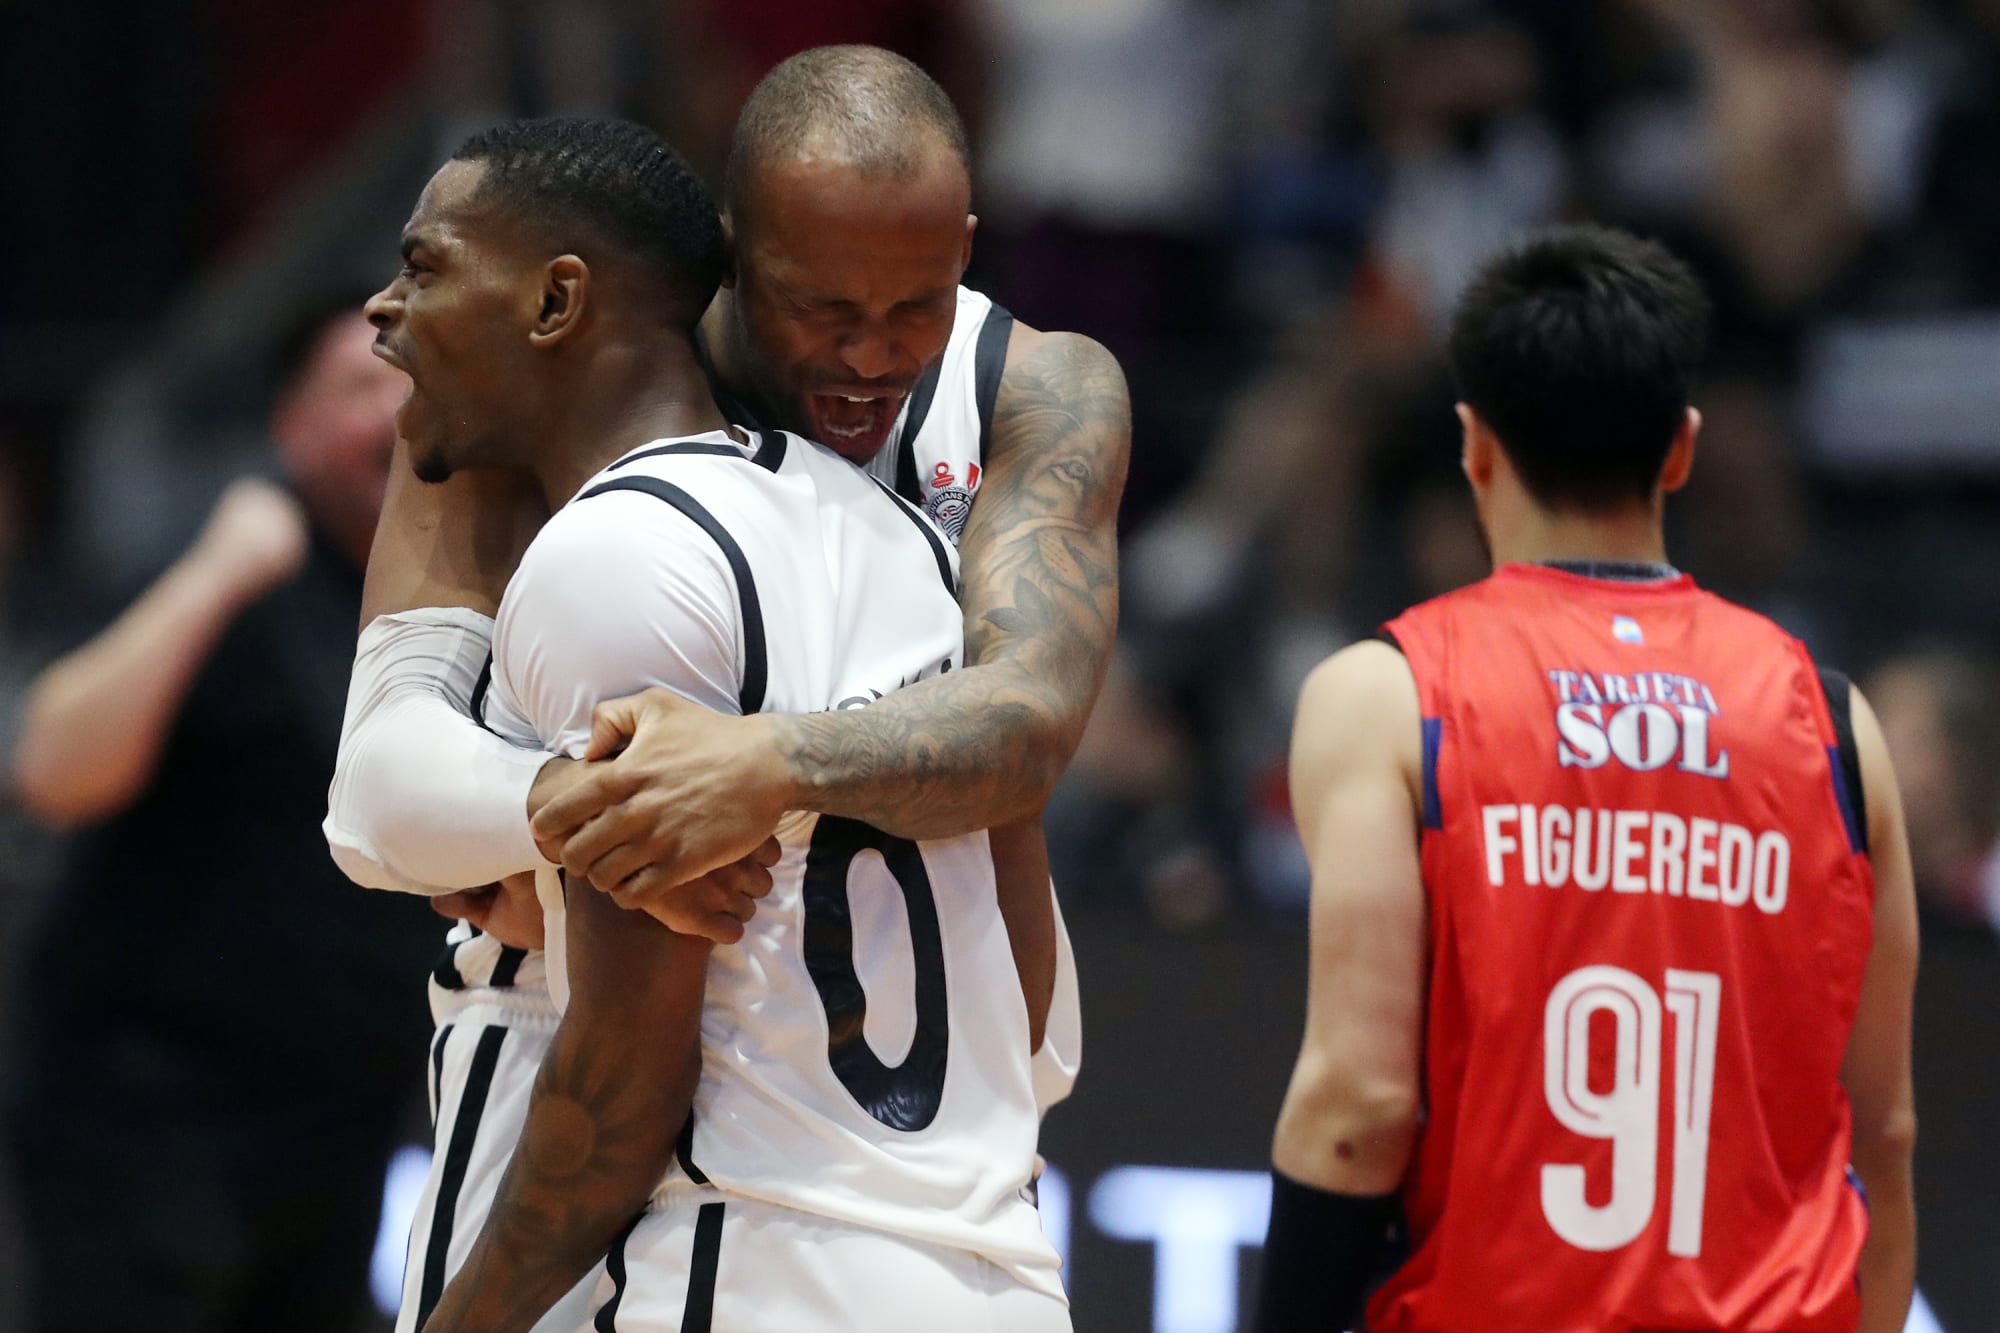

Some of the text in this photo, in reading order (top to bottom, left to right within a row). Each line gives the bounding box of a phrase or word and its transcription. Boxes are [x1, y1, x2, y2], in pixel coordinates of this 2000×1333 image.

[1549, 669, 1721, 715] TARJETA
[1556, 702, 1729, 779] SOL
[1482, 803, 1790, 914] FIGUEREDO
[803, 813, 949, 1132] 0
[1541, 964, 1722, 1258] 91
